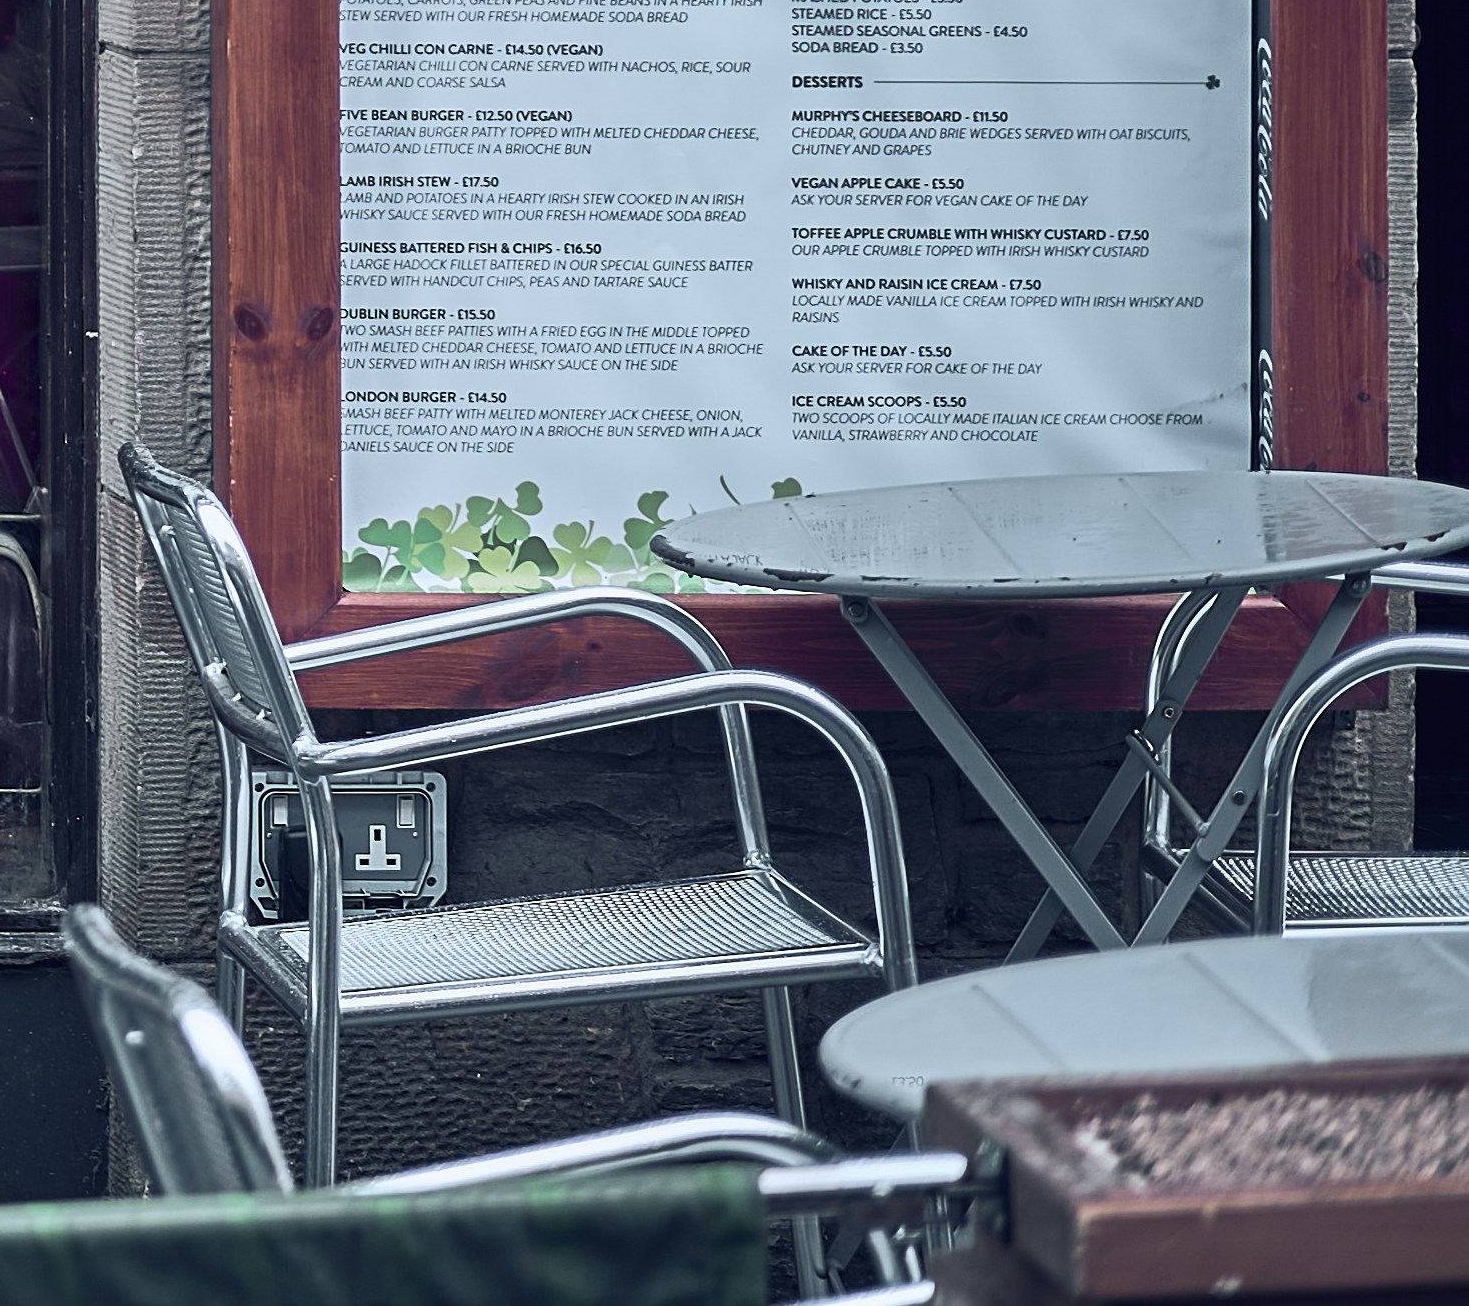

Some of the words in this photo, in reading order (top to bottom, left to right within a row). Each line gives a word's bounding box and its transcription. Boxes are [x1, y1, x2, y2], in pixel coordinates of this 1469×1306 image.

[791, 75, 864, 89] DESSERTS
[790, 143, 851, 156] CHUTNEY
[851, 143, 881, 156] AND
[881, 143, 933, 157] GRAPES
[789, 361, 816, 374] ASK
[818, 361, 854, 374] YOUR
[855, 361, 903, 374] SERVER
[904, 362, 933, 375] FOR
[933, 362, 969, 375] CAKE
[969, 362, 989, 375] OF
[991, 362, 1015, 375] THE
[1016, 362, 1043, 375] DAY
[791, 395, 814, 408] ICE
[816, 395, 865, 408] CREAM
[867, 395, 923, 408] SCOOPS
[932, 395, 967, 408] £5.50
[792, 429, 845, 443] VANILLA,
[848, 429, 929, 442] STRAWBERRY
[929, 429, 959, 442] AND
[959, 429, 1038, 443] CHOCOLATE
